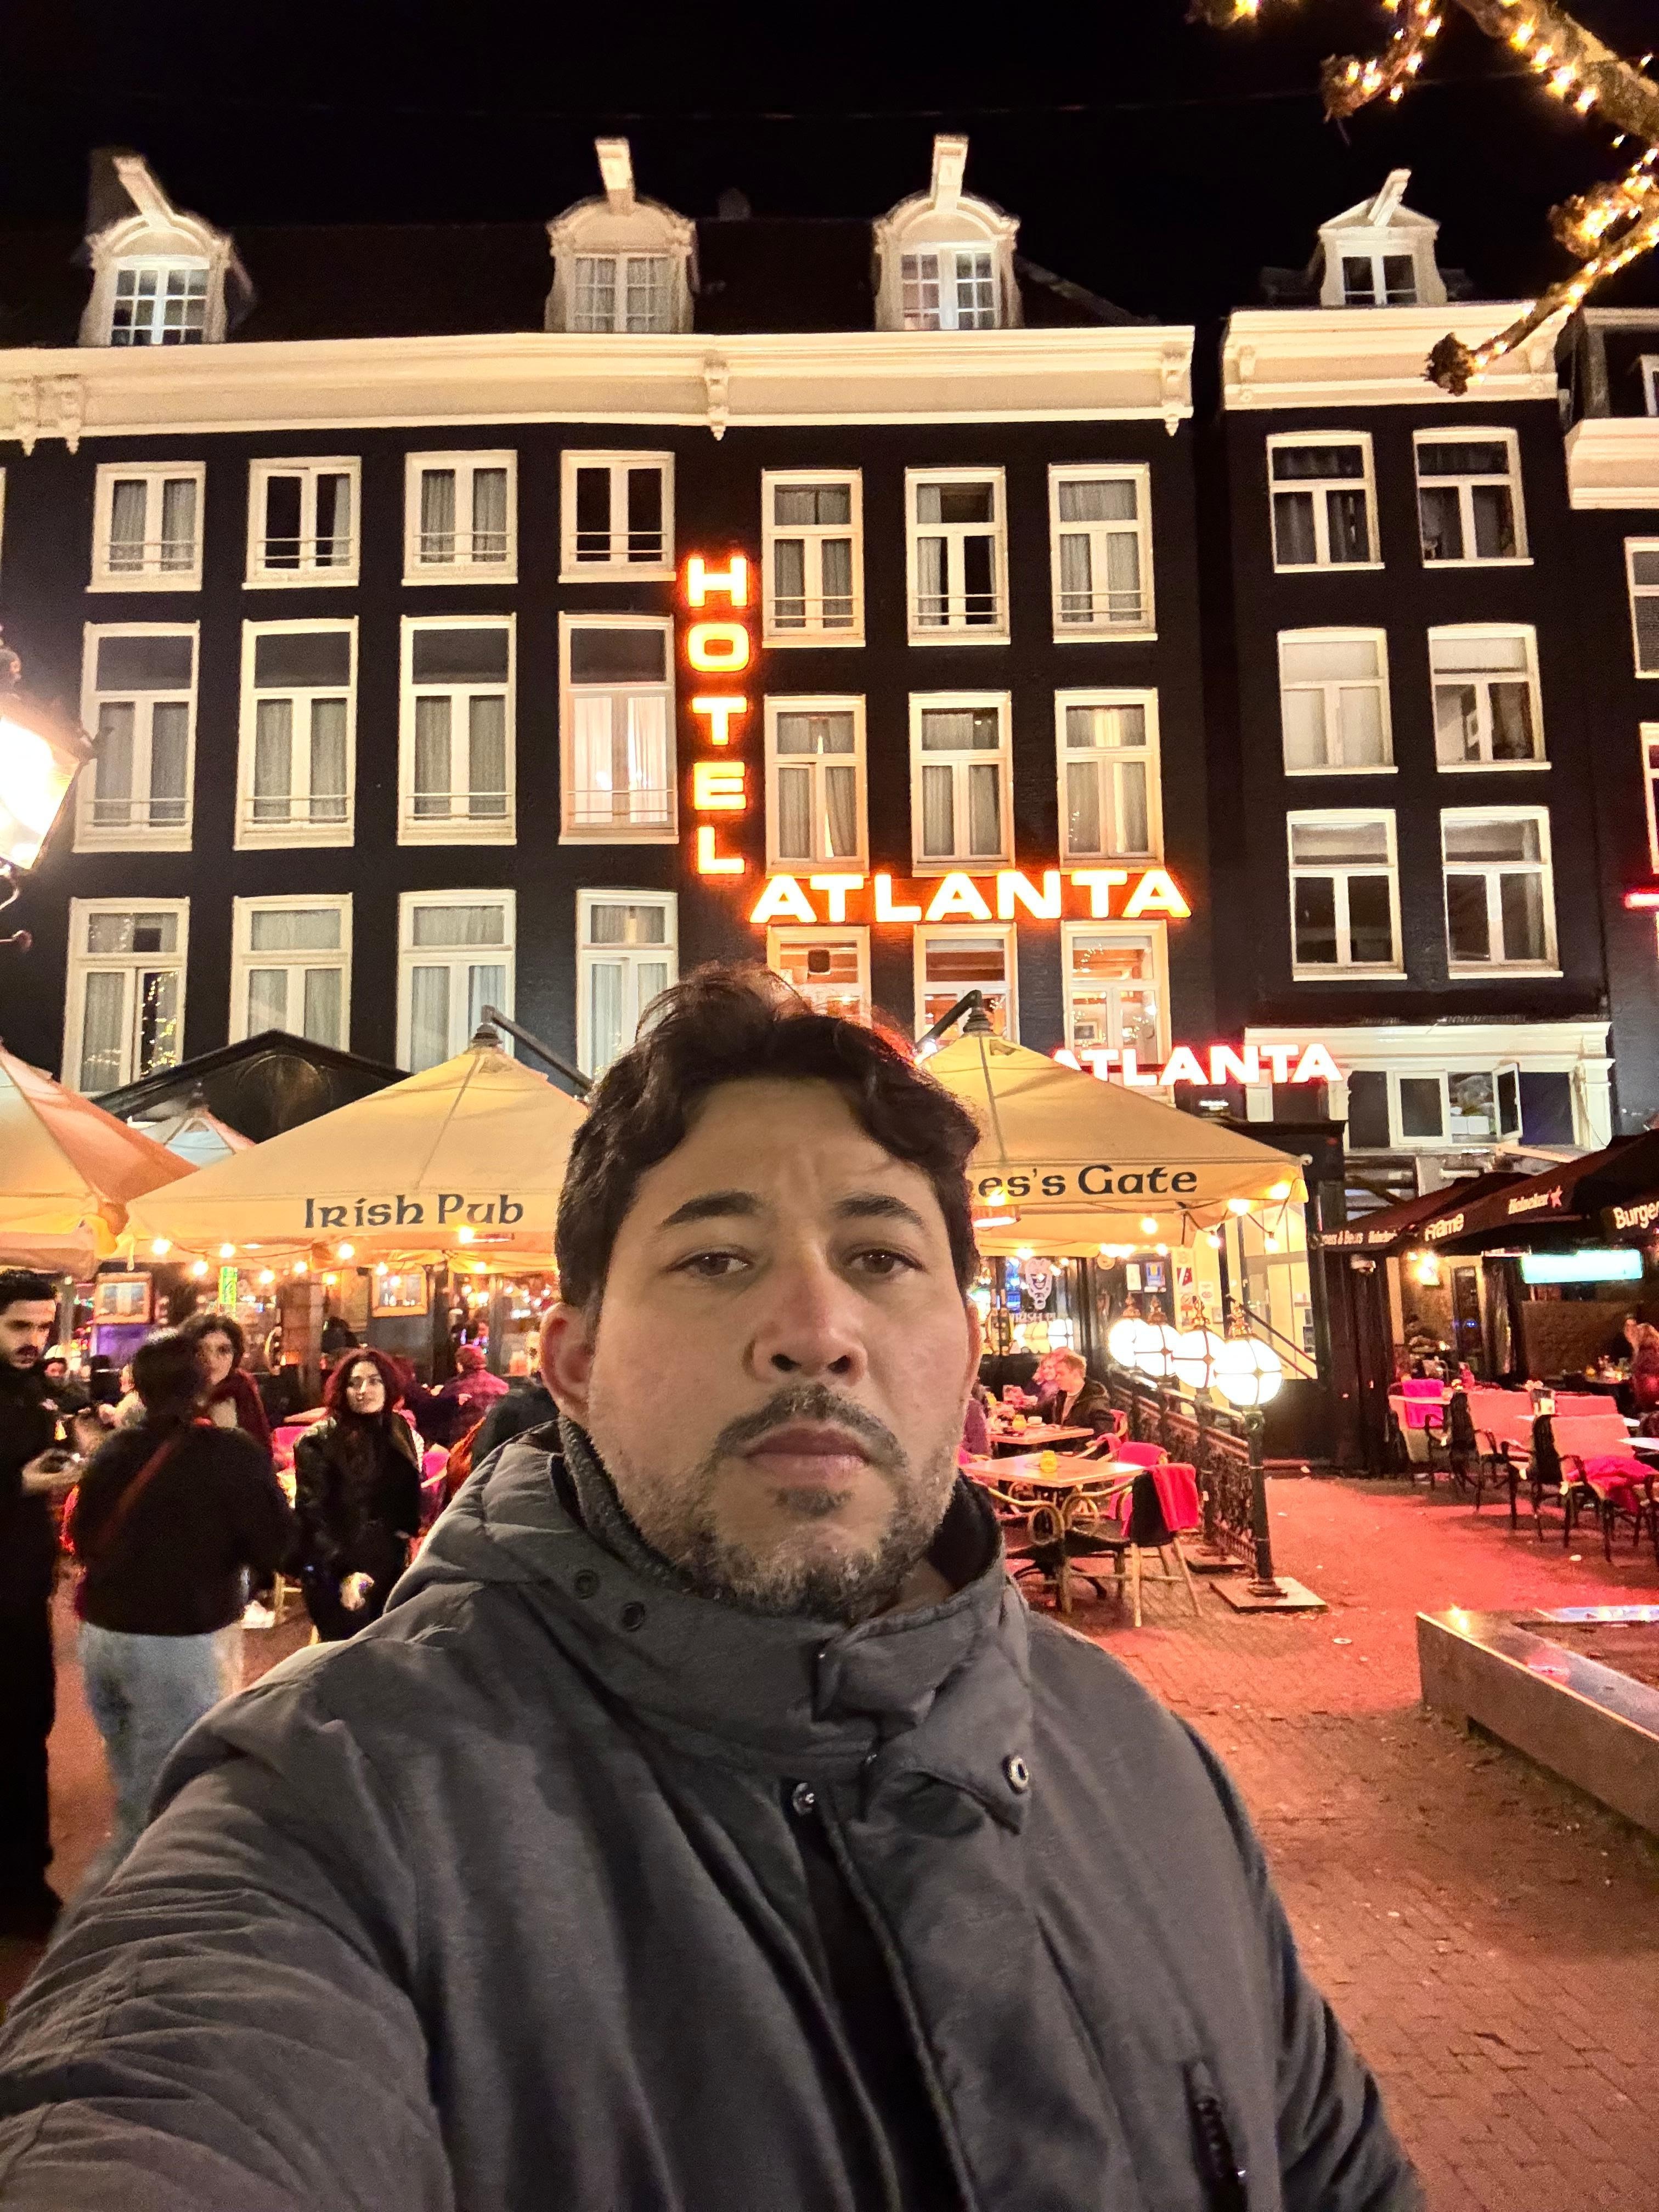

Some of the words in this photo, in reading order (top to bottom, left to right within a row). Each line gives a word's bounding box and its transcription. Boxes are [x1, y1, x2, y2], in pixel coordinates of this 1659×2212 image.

[687, 557, 750, 874] HOTEL
[748, 869, 1193, 923] ATLANTA
[978, 1168, 1066, 1198] es's
[1077, 1164, 1198, 1194] Gate
[304, 1194, 425, 1228] Irish
[438, 1193, 524, 1224] Pub
